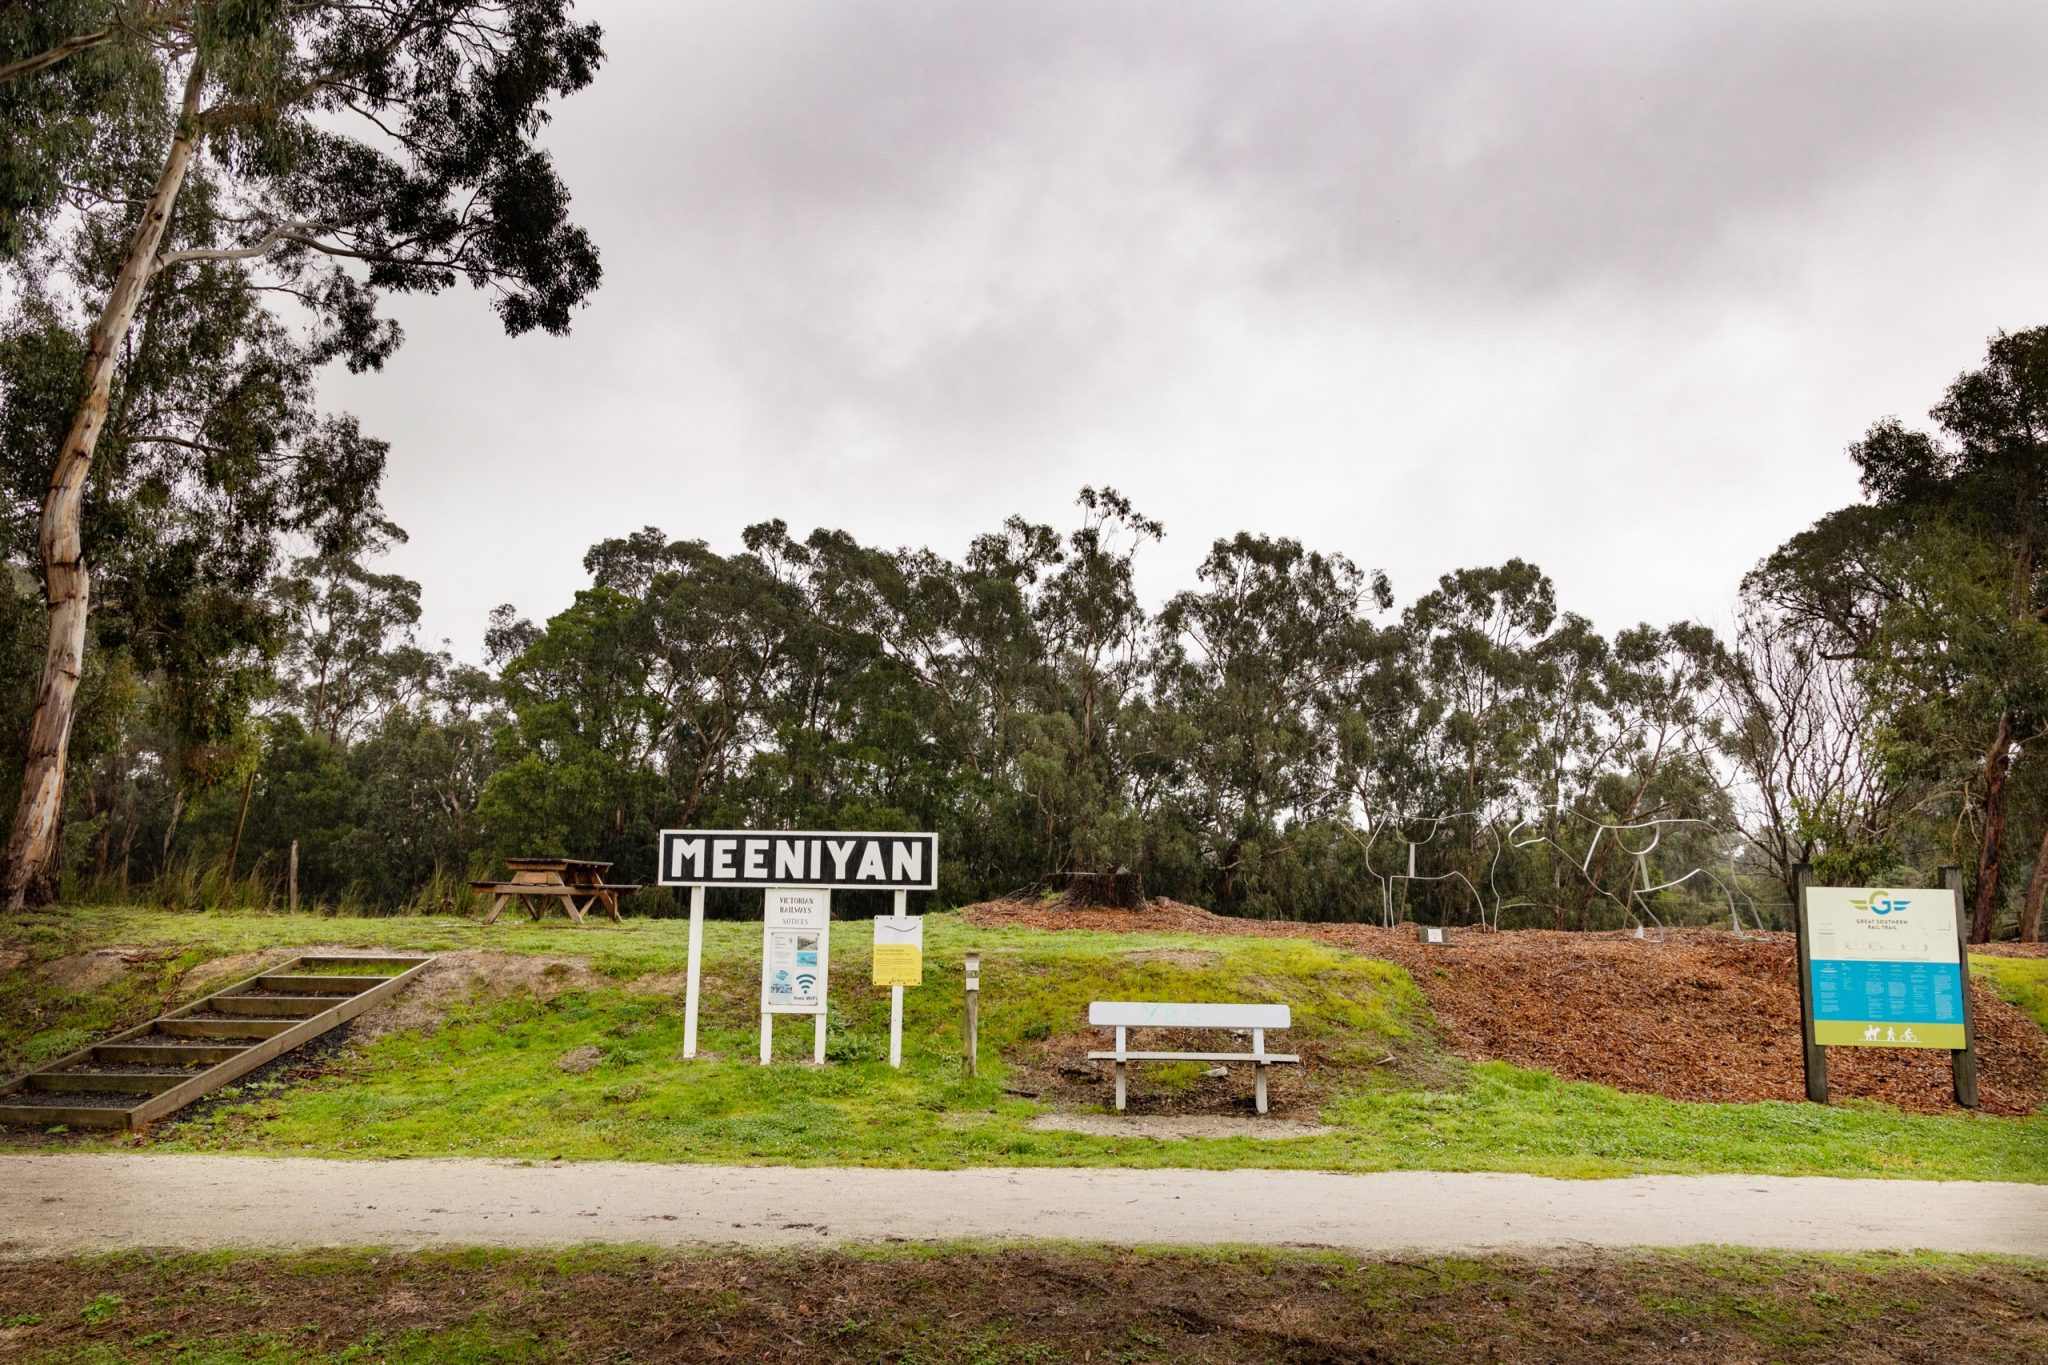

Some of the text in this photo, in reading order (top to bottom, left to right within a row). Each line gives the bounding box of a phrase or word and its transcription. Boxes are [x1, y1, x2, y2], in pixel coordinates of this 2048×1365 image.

[671, 838, 923, 881] MEENIYAN
[779, 896, 814, 905] VICTORIAN
[779, 906, 813, 914] RAILWAYS
